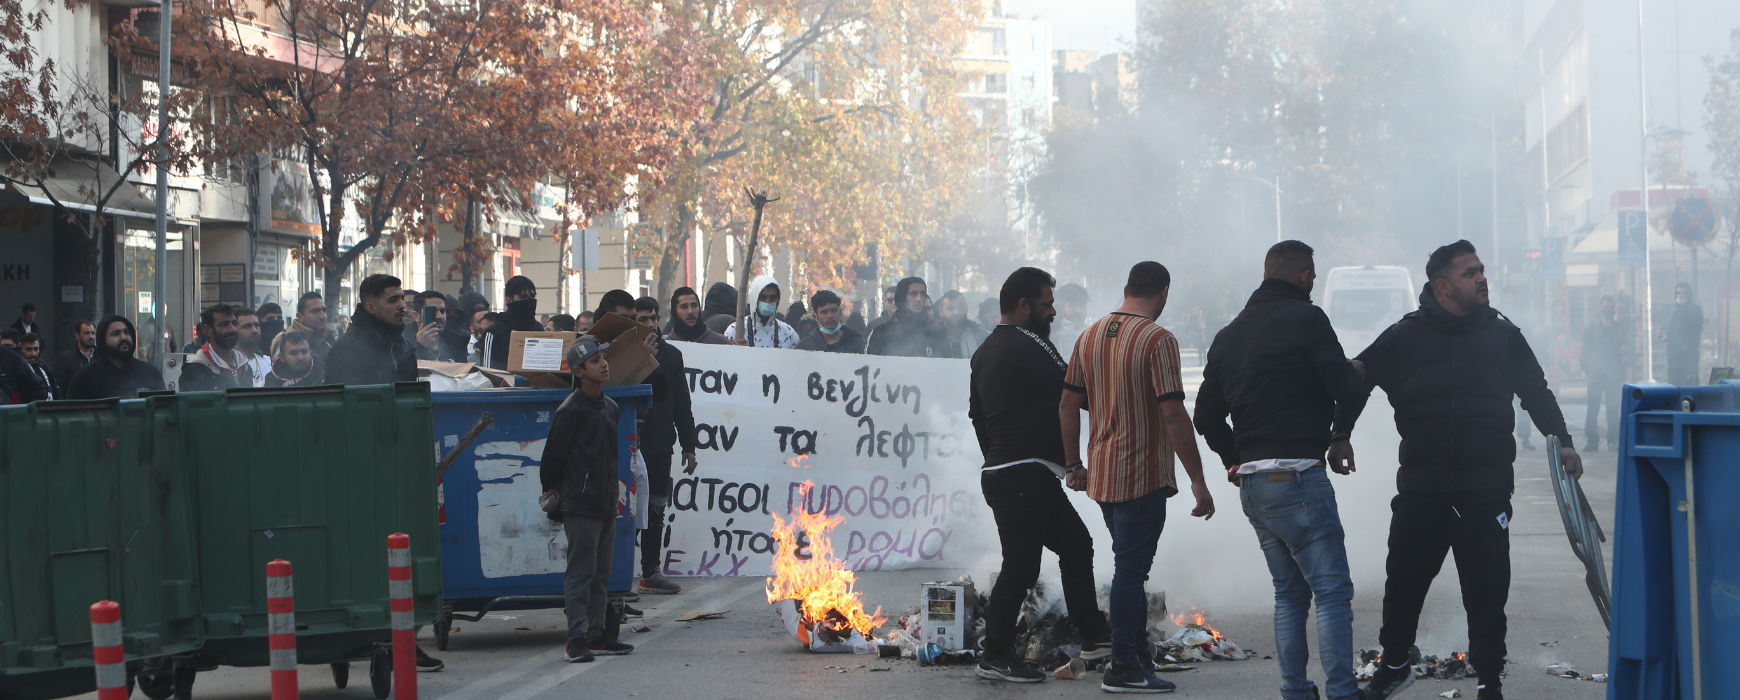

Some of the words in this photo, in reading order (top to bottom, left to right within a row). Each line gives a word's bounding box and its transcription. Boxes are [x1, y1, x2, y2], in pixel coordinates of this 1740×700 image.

[1625, 212, 1640, 236] P
[3, 263, 30, 281] ΚΗ
[684, 367, 738, 396] ταν
[762, 374, 780, 404] η
[807, 365, 921, 417] βενζίνη
[694, 423, 739, 452] αν
[774, 425, 817, 455] τα
